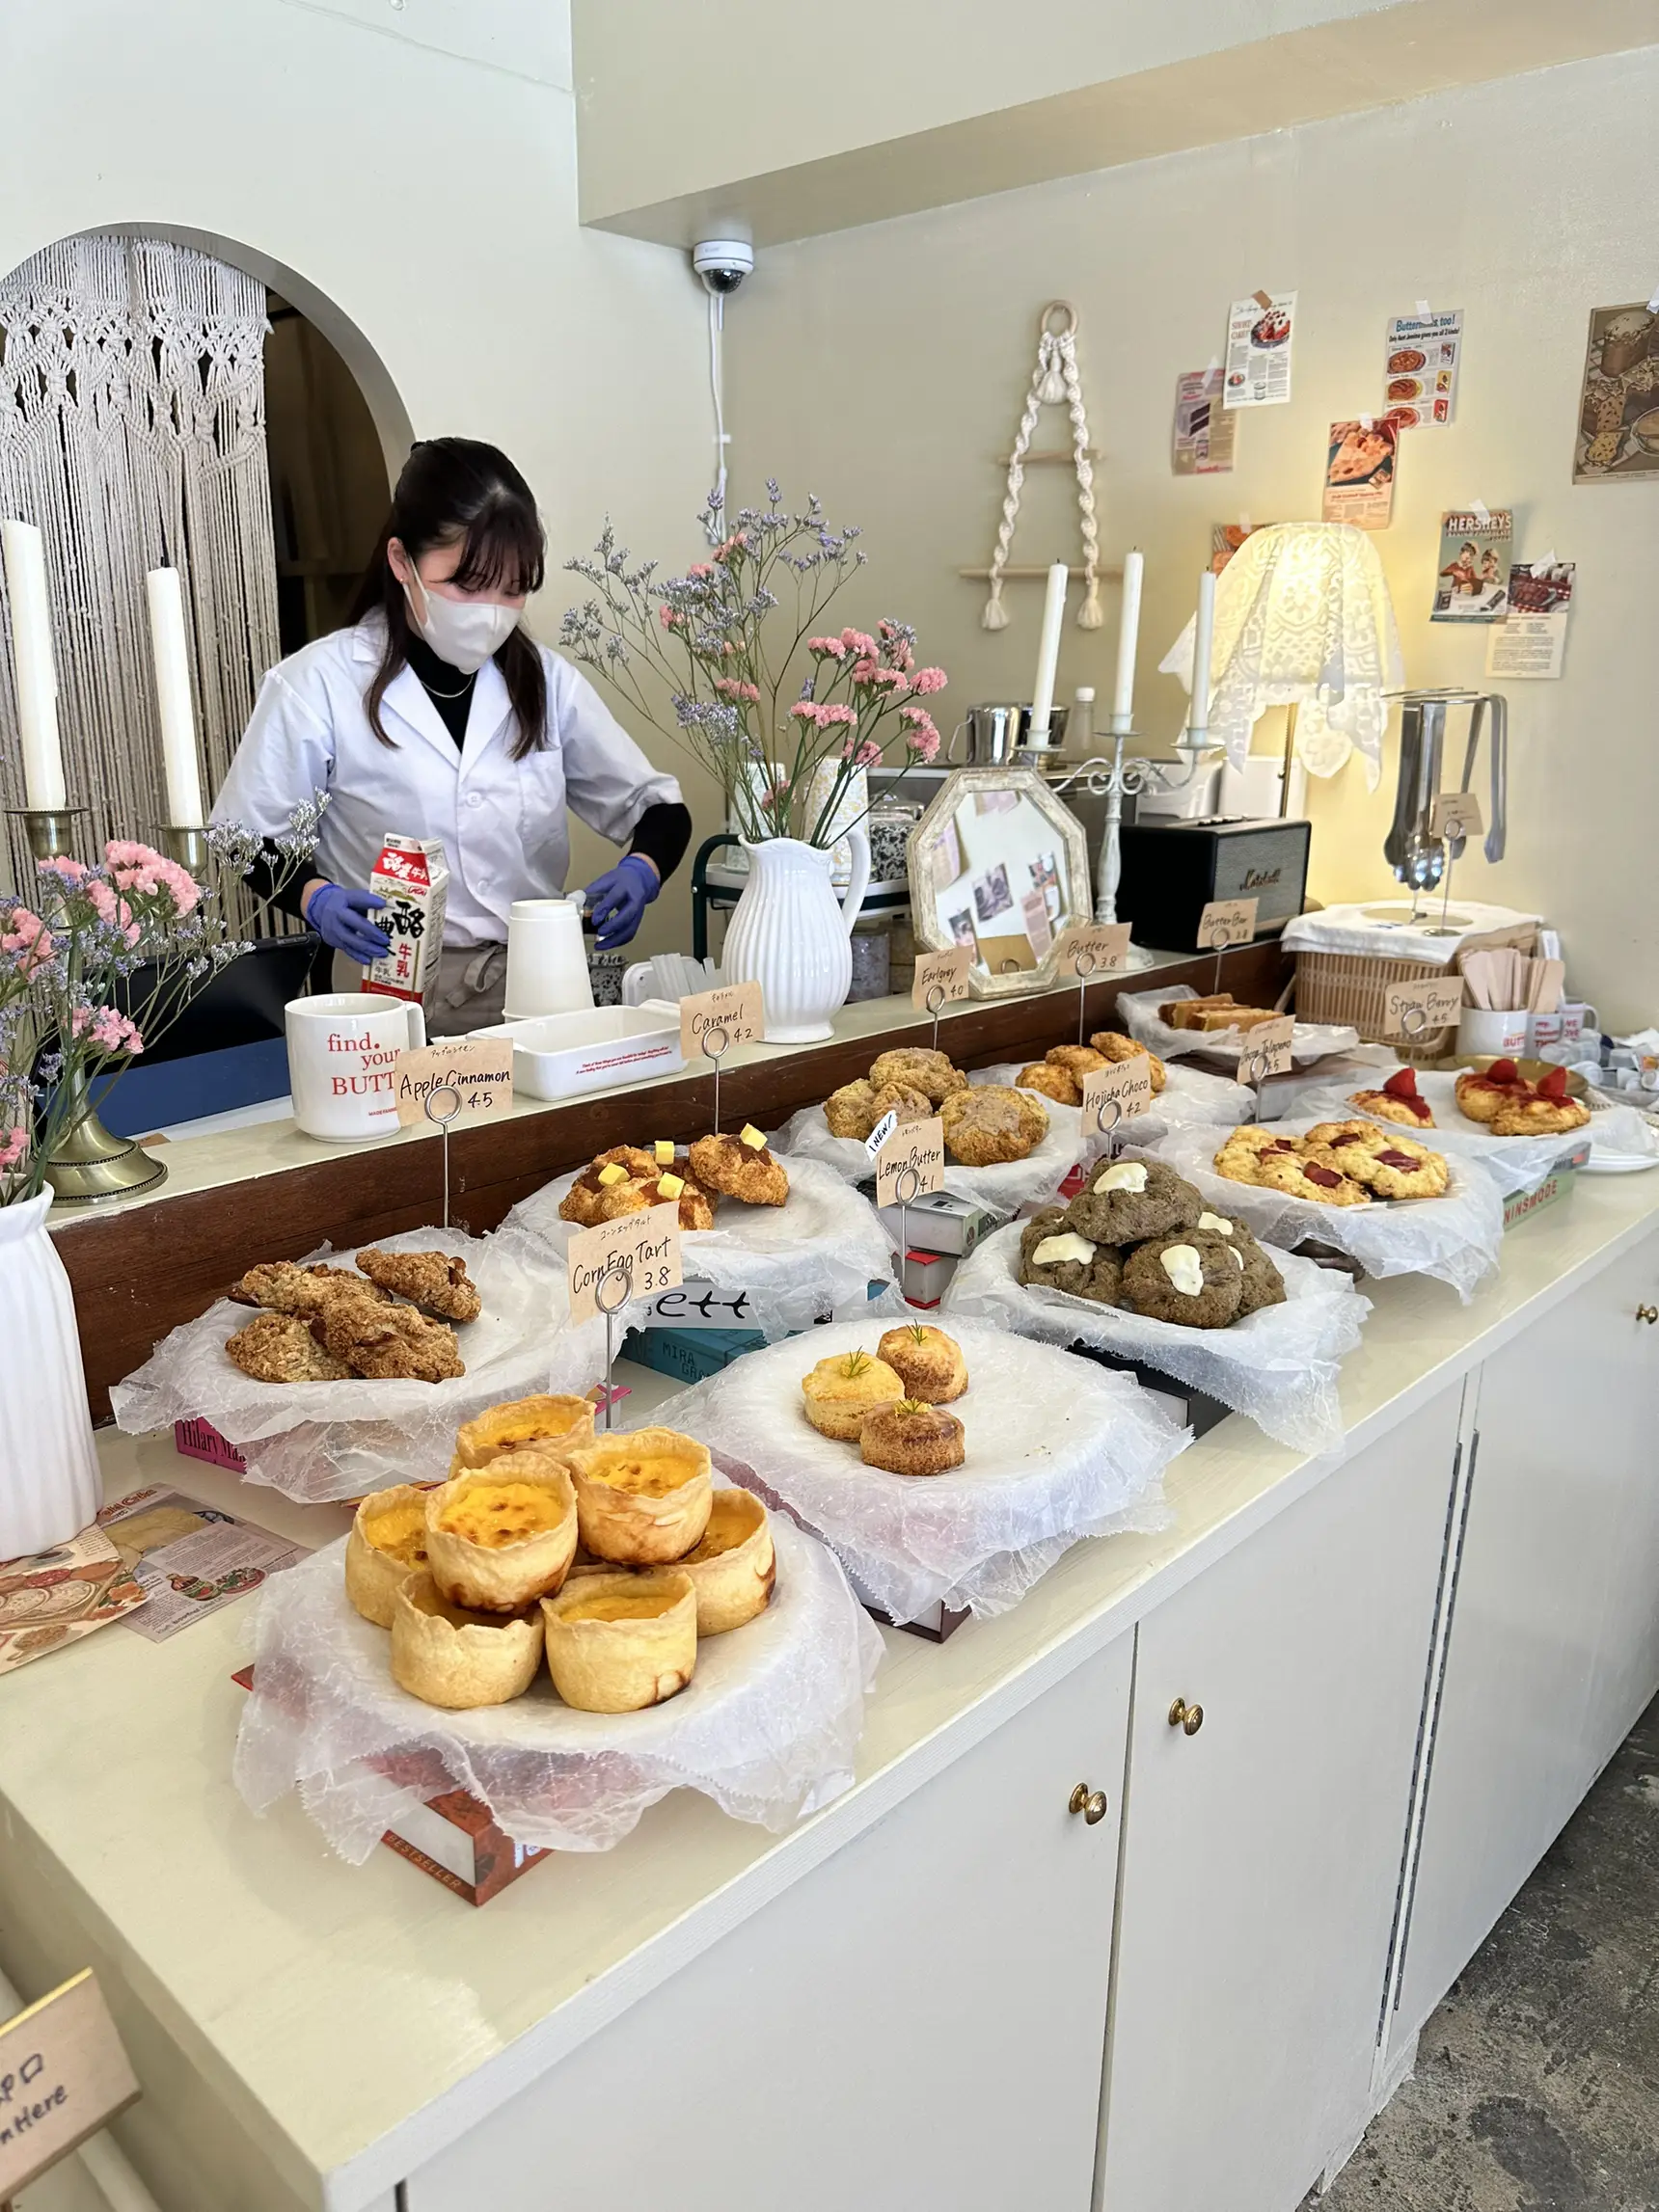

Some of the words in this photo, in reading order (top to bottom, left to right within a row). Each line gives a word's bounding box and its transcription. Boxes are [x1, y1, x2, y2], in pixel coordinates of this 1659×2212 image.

[1440, 313, 1455, 326] too!
[1203, 913, 1231, 930] Butter
[396, 942, 412, 978] 牛乳
[1067, 939, 1109, 959] Butter
[951, 985, 964, 997] 4.0
[692, 1003, 744, 1035] Caramel
[327, 1032, 380, 1052] find.
[361, 1048, 400, 1070] your
[400, 1072, 444, 1101] Apple
[446, 1069, 510, 1087] Cinnamon
[1121, 1079, 1148, 1098] Choco
[468, 1091, 493, 1109] 4.5
[1127, 1101, 1141, 1118] 4.2
[873, 1122, 889, 1147] NEW
[879, 1155, 908, 1181] Lemon
[910, 1146, 941, 1169] Butter
[573, 1263, 606, 1294] Corn
[607, 1250, 634, 1281] Egg
[635, 1236, 671, 1263] Tart
[644, 1266, 671, 1290] 3.8
[647, 1290, 750, 1319] ett
[663, 1342, 694, 1365] MIRA
[681, 1362, 712, 1381] GRA
[387, 1834, 462, 1889] BESTSELLER
[14, 2085, 68, 2133] Here
